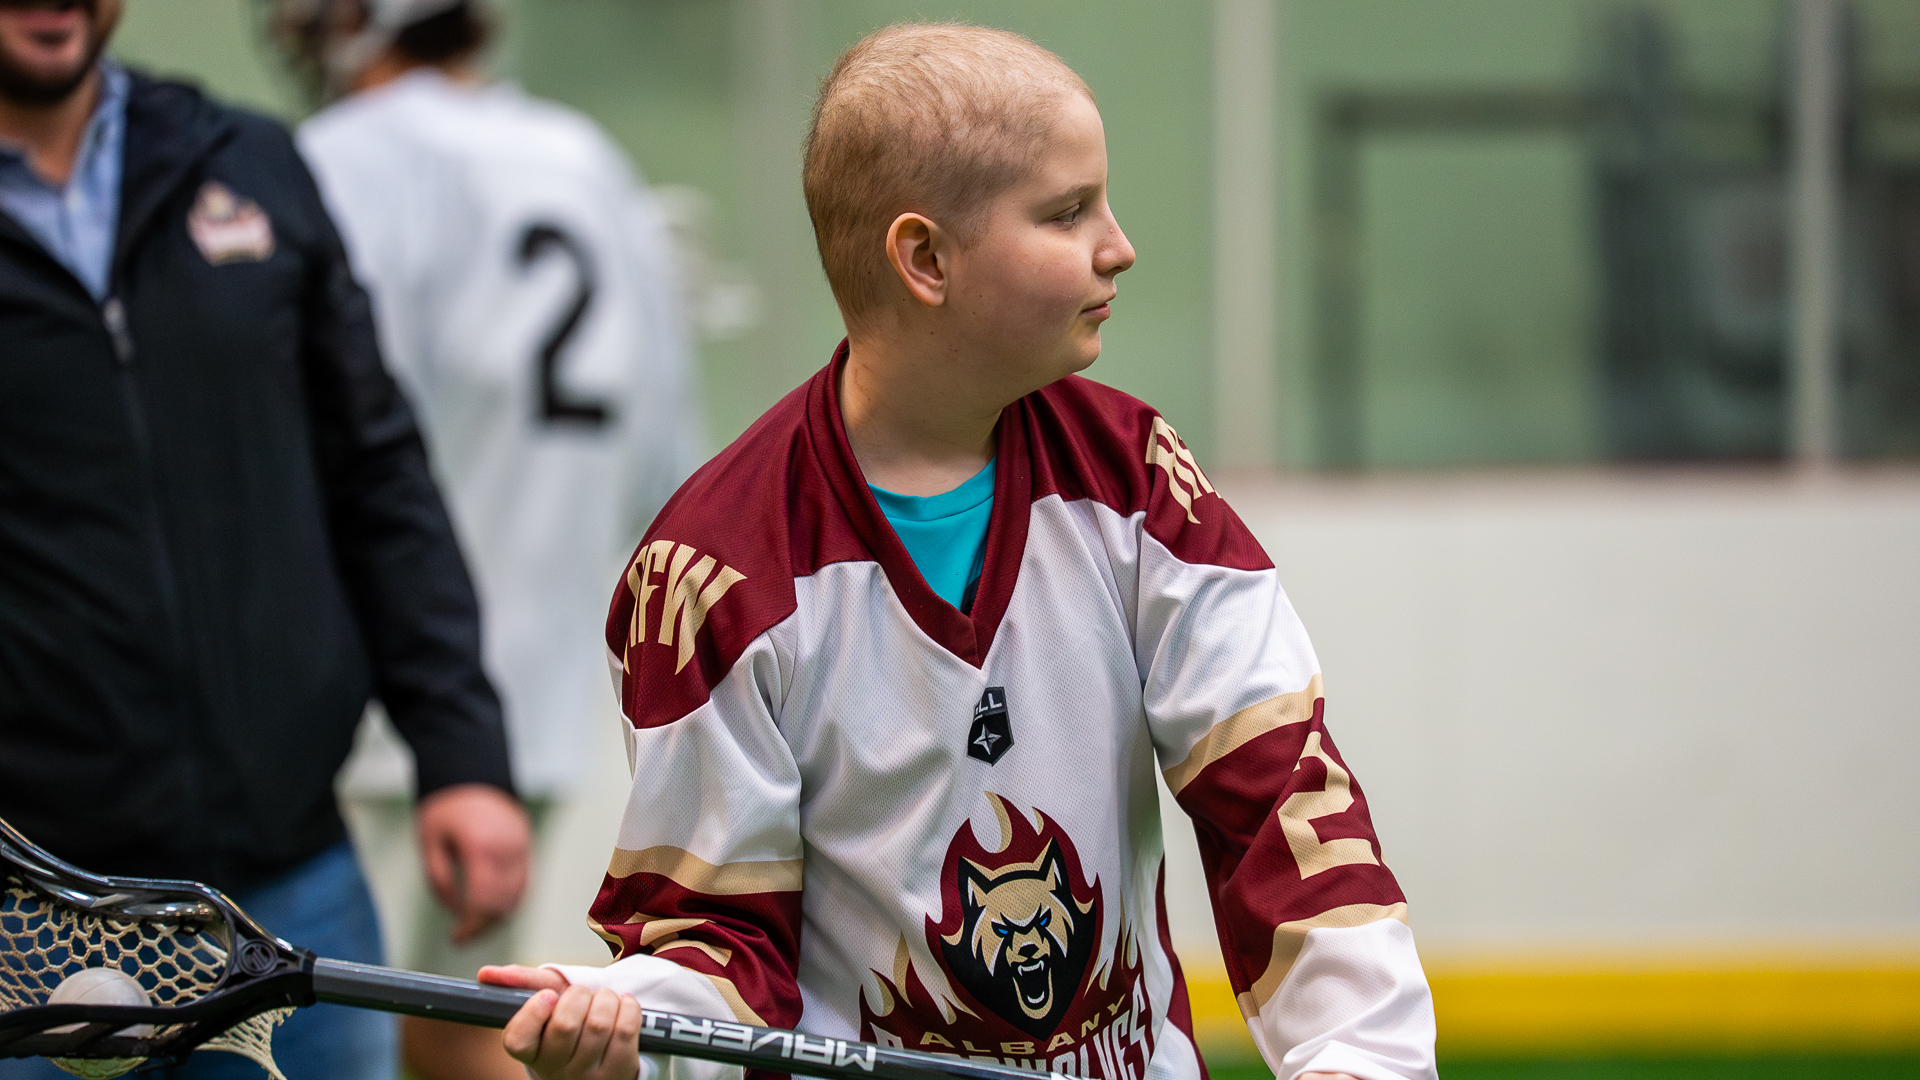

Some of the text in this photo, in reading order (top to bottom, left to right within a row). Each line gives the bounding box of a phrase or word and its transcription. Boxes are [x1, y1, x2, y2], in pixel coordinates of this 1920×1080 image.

[517, 224, 611, 426] 2
[975, 693, 1002, 715] LL
[1277, 731, 1380, 880] 2
[641, 1009, 877, 1072] MAVERI
[920, 993, 1126, 1055] ALBANY
